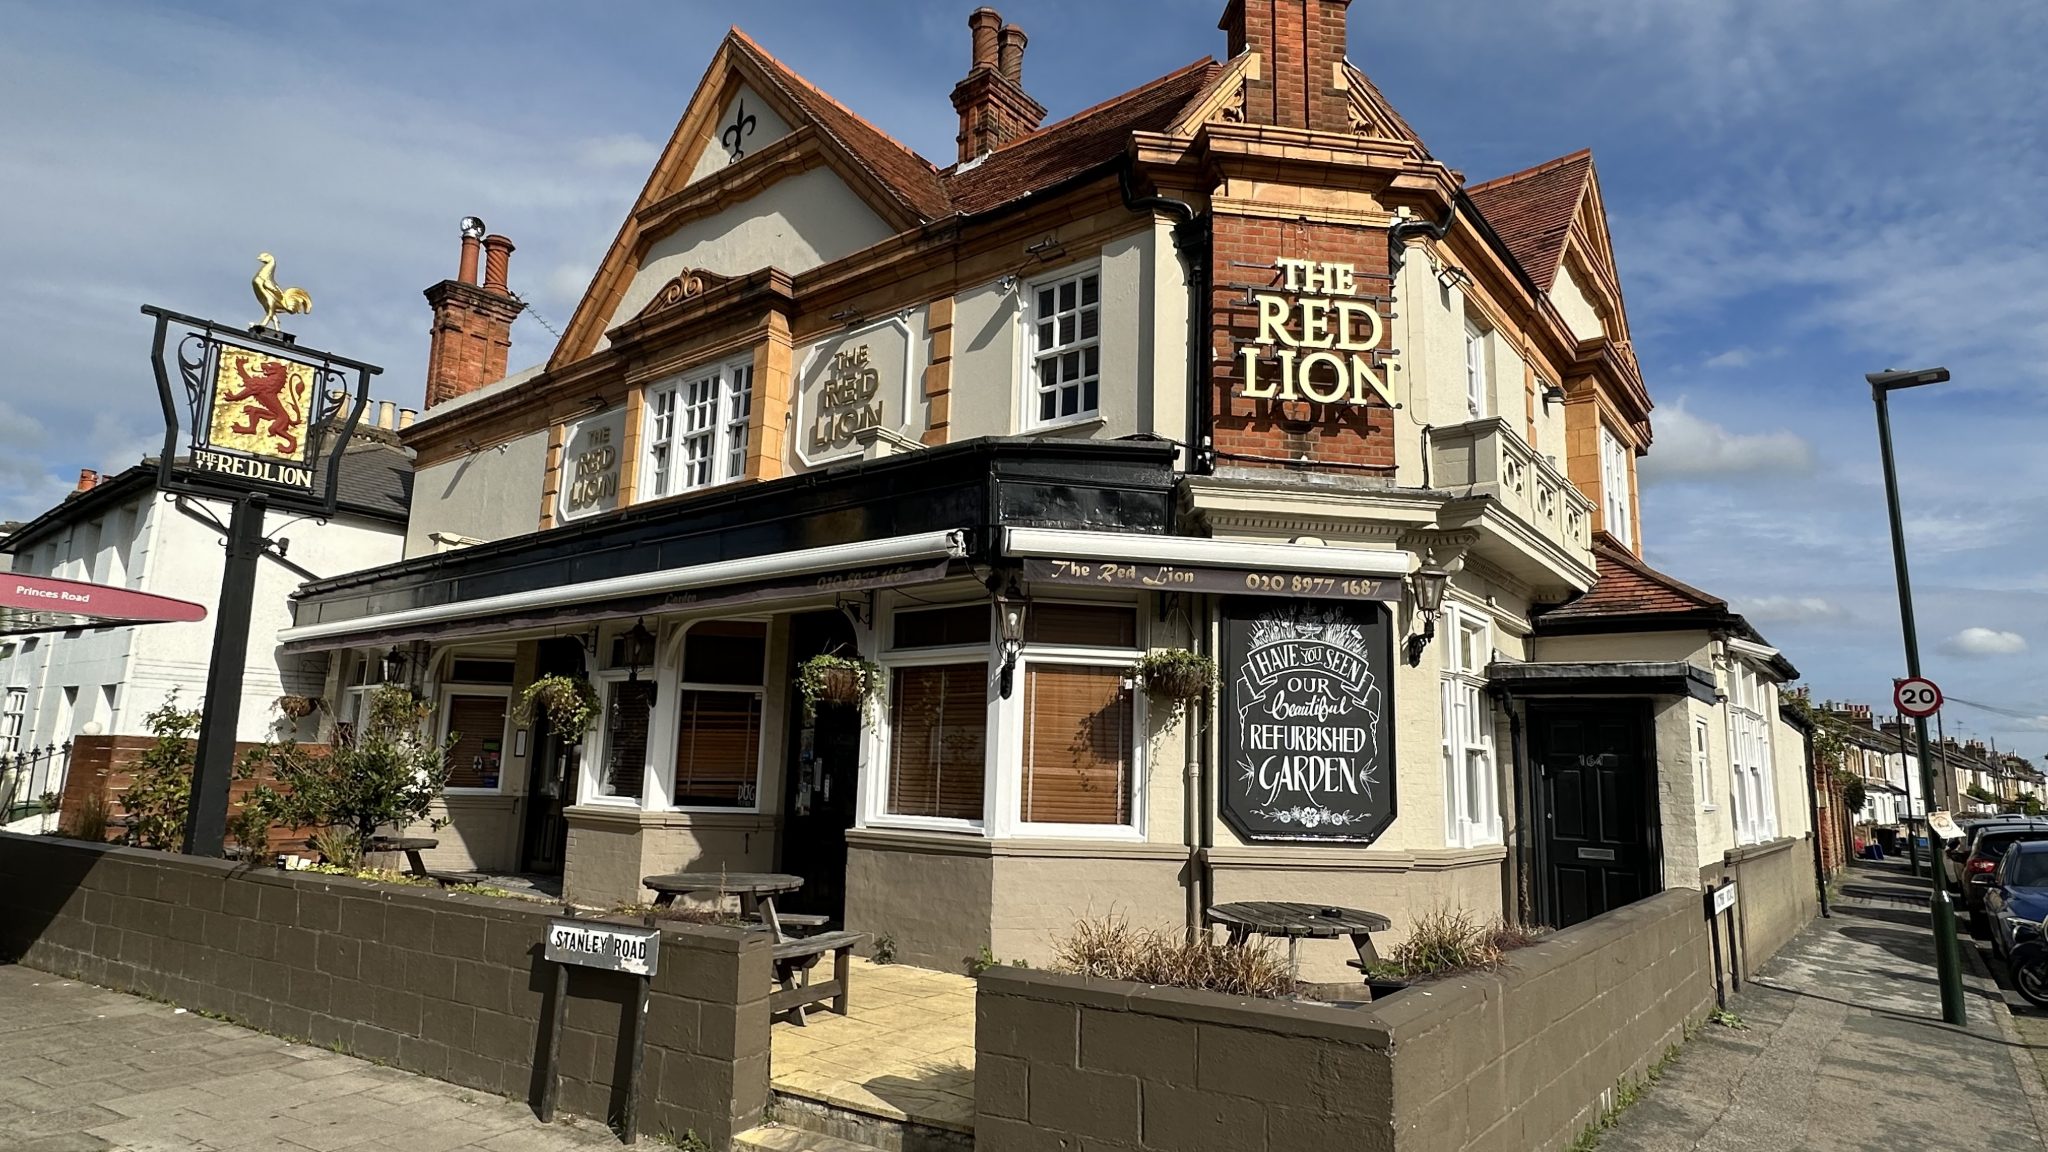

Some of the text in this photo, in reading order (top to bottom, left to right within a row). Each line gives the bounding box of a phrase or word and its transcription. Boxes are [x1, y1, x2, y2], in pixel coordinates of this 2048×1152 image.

[1276, 256, 1358, 296] THE
[1254, 294, 1383, 351] RED
[834, 344, 871, 371] THE
[823, 368, 879, 409] RED
[1240, 346, 1399, 409] LION
[587, 425, 611, 447] THE
[814, 400, 884, 447] LION
[194, 450, 219, 463] THE
[577, 445, 616, 476] RED
[570, 472, 618, 508] LION
[16, 585, 90, 603] Princes Road
[1051, 560, 1382, 596] The Red Lion 020 8977 1687
[1254, 643, 1362, 682] HAVE YOU SEEN
[1287, 677, 1340, 700] OUR
[1901, 688, 1935, 704] 20
[1250, 724, 1367, 753] REFURBISHED
[1258, 755, 1360, 808] GARDEN
[555, 931, 646, 960] STANLEY ROAD
